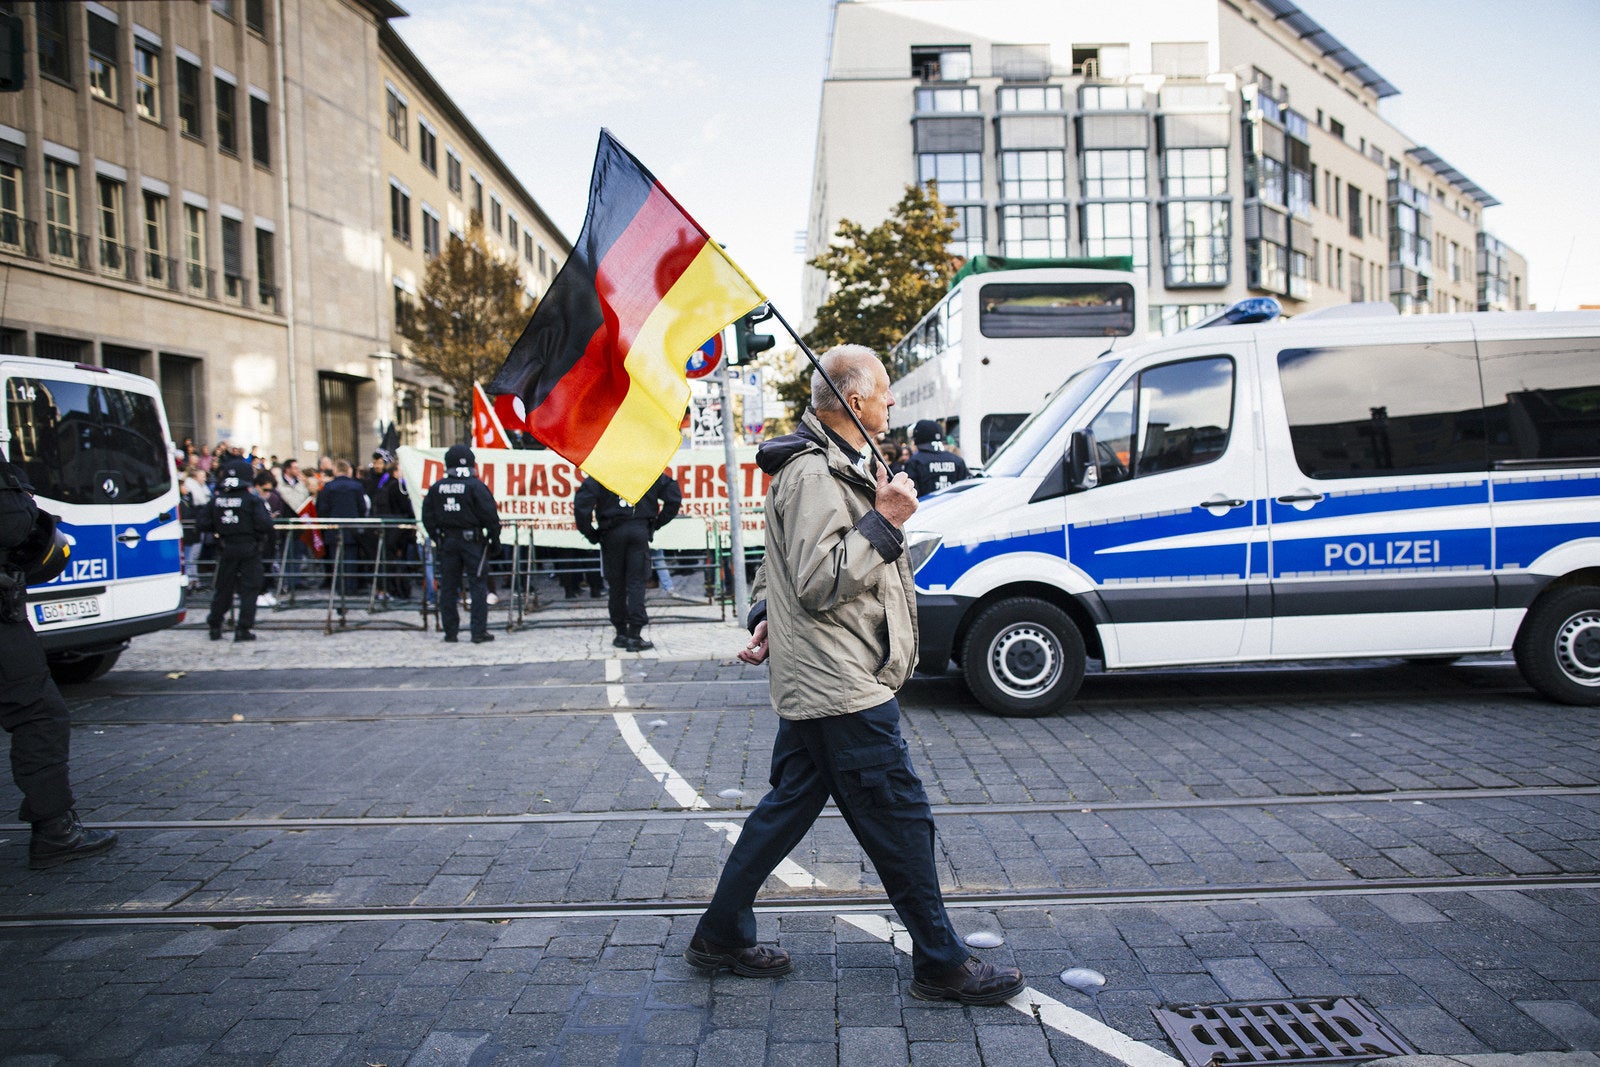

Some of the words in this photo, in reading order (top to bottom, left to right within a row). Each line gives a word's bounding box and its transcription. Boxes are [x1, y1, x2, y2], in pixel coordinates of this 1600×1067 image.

[17, 386, 37, 401] 14
[422, 459, 495, 498] DM
[1324, 539, 1440, 567] POLIZEI
[48, 558, 107, 584] LIZEI
